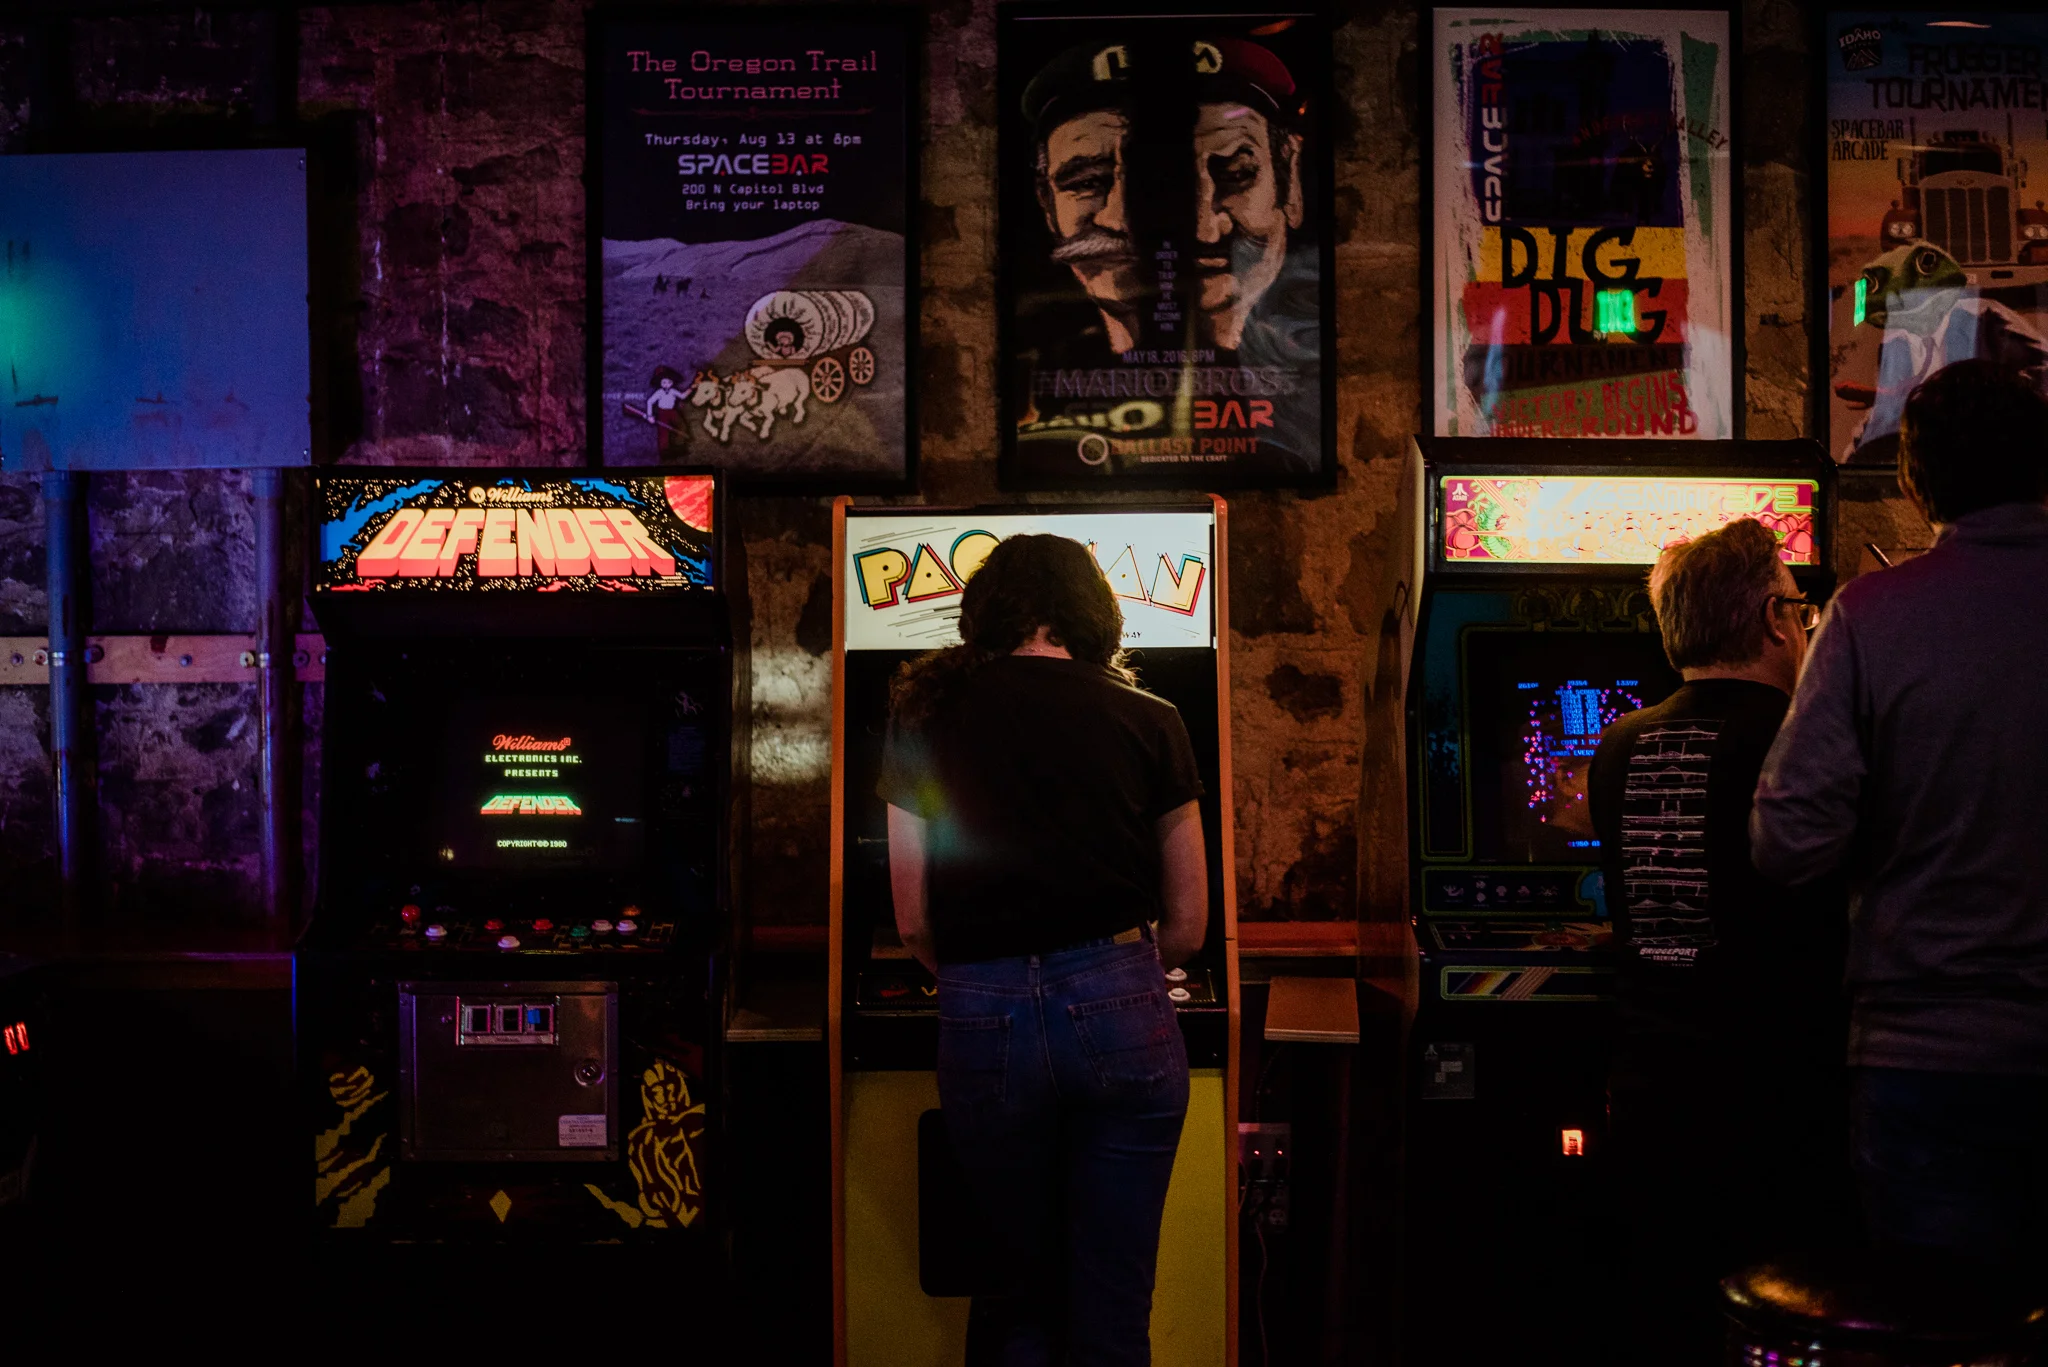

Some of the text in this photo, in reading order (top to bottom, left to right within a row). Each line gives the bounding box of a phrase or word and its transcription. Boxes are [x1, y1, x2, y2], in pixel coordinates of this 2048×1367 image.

[1838, 27, 1882, 48] IDAHO
[626, 50, 878, 74] The Oregon Trail
[664, 78, 843, 100] Tournament
[1866, 76, 2048, 112] TOURNAME
[1480, 33, 1509, 223] SPACEBAR
[1832, 119, 1904, 139] SPACEBAR
[645, 133, 729, 148] Thursday,
[739, 133, 767, 148] Aug
[776, 133, 796, 146] 13
[805, 135, 824, 146] at
[1832, 140, 1888, 160] ARCADE
[677, 153, 831, 177] SPACEBAR
[682, 183, 825, 197] 200 N Capitol Blvd
[685, 200, 820, 213] Bring your laptop
[1501, 226, 1641, 288] DIG
[1530, 277, 1668, 345] DUG
[1122, 351, 1144, 364] MAY
[1192, 350, 1215, 363] 8PM
[1054, 367, 1172, 398] MARIO
[1491, 372, 1687, 420] VICTORY BEGINS
[1489, 404, 1698, 438] UNDERGROUND
[1110, 437, 1259, 455] BALLAST POINT
[485, 487, 554, 504] Williams
[357, 508, 676, 577] DEFENDER
[485, 755, 582, 763] ELECTRONICS INC.
[505, 769, 559, 777] PRESENTS
[480, 795, 582, 815] DEFENDER
[1639, 948, 1698, 957] BRIDGEPORT
